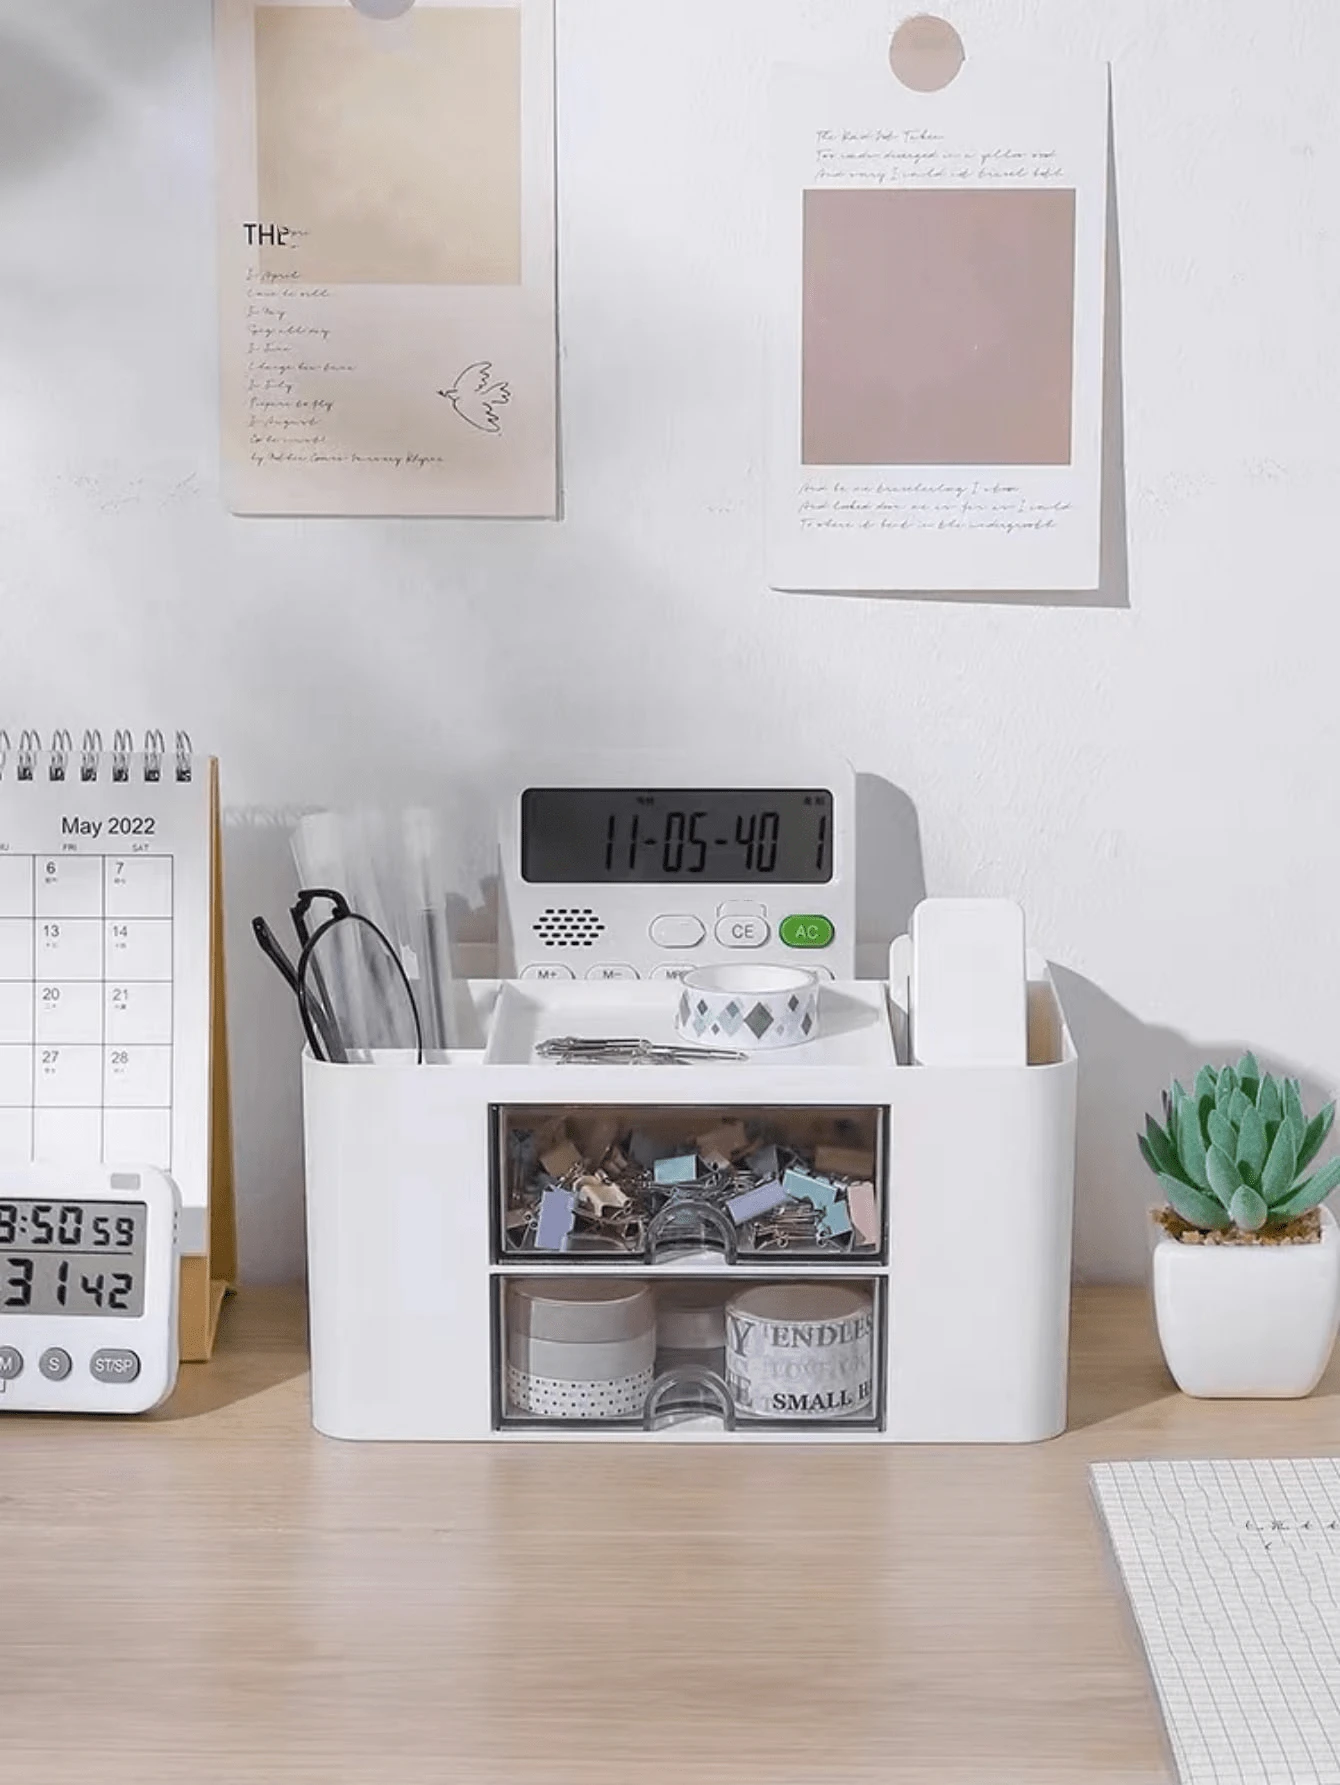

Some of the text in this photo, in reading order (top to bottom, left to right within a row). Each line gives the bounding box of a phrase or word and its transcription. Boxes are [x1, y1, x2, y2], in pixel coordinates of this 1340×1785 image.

[61, 817, 156, 838] May 2022
[45, 861, 56, 875] 6
[116, 862, 125, 875] 7
[43, 924, 60, 938] 13
[113, 925, 128, 938] 14
[731, 923, 755, 939] CE
[795, 923, 819, 940] AC
[42, 987, 60, 1001] 20
[112, 988, 129, 1002] 21
[42, 1050, 60, 1064] 27
[111, 1051, 129, 1065] 28
[92, 1217, 134, 1246] 59
[48, 1357, 60, 1372] S
[95, 1358, 134, 1373] ST/SP
[772, 1390, 853, 1411] SMALL
